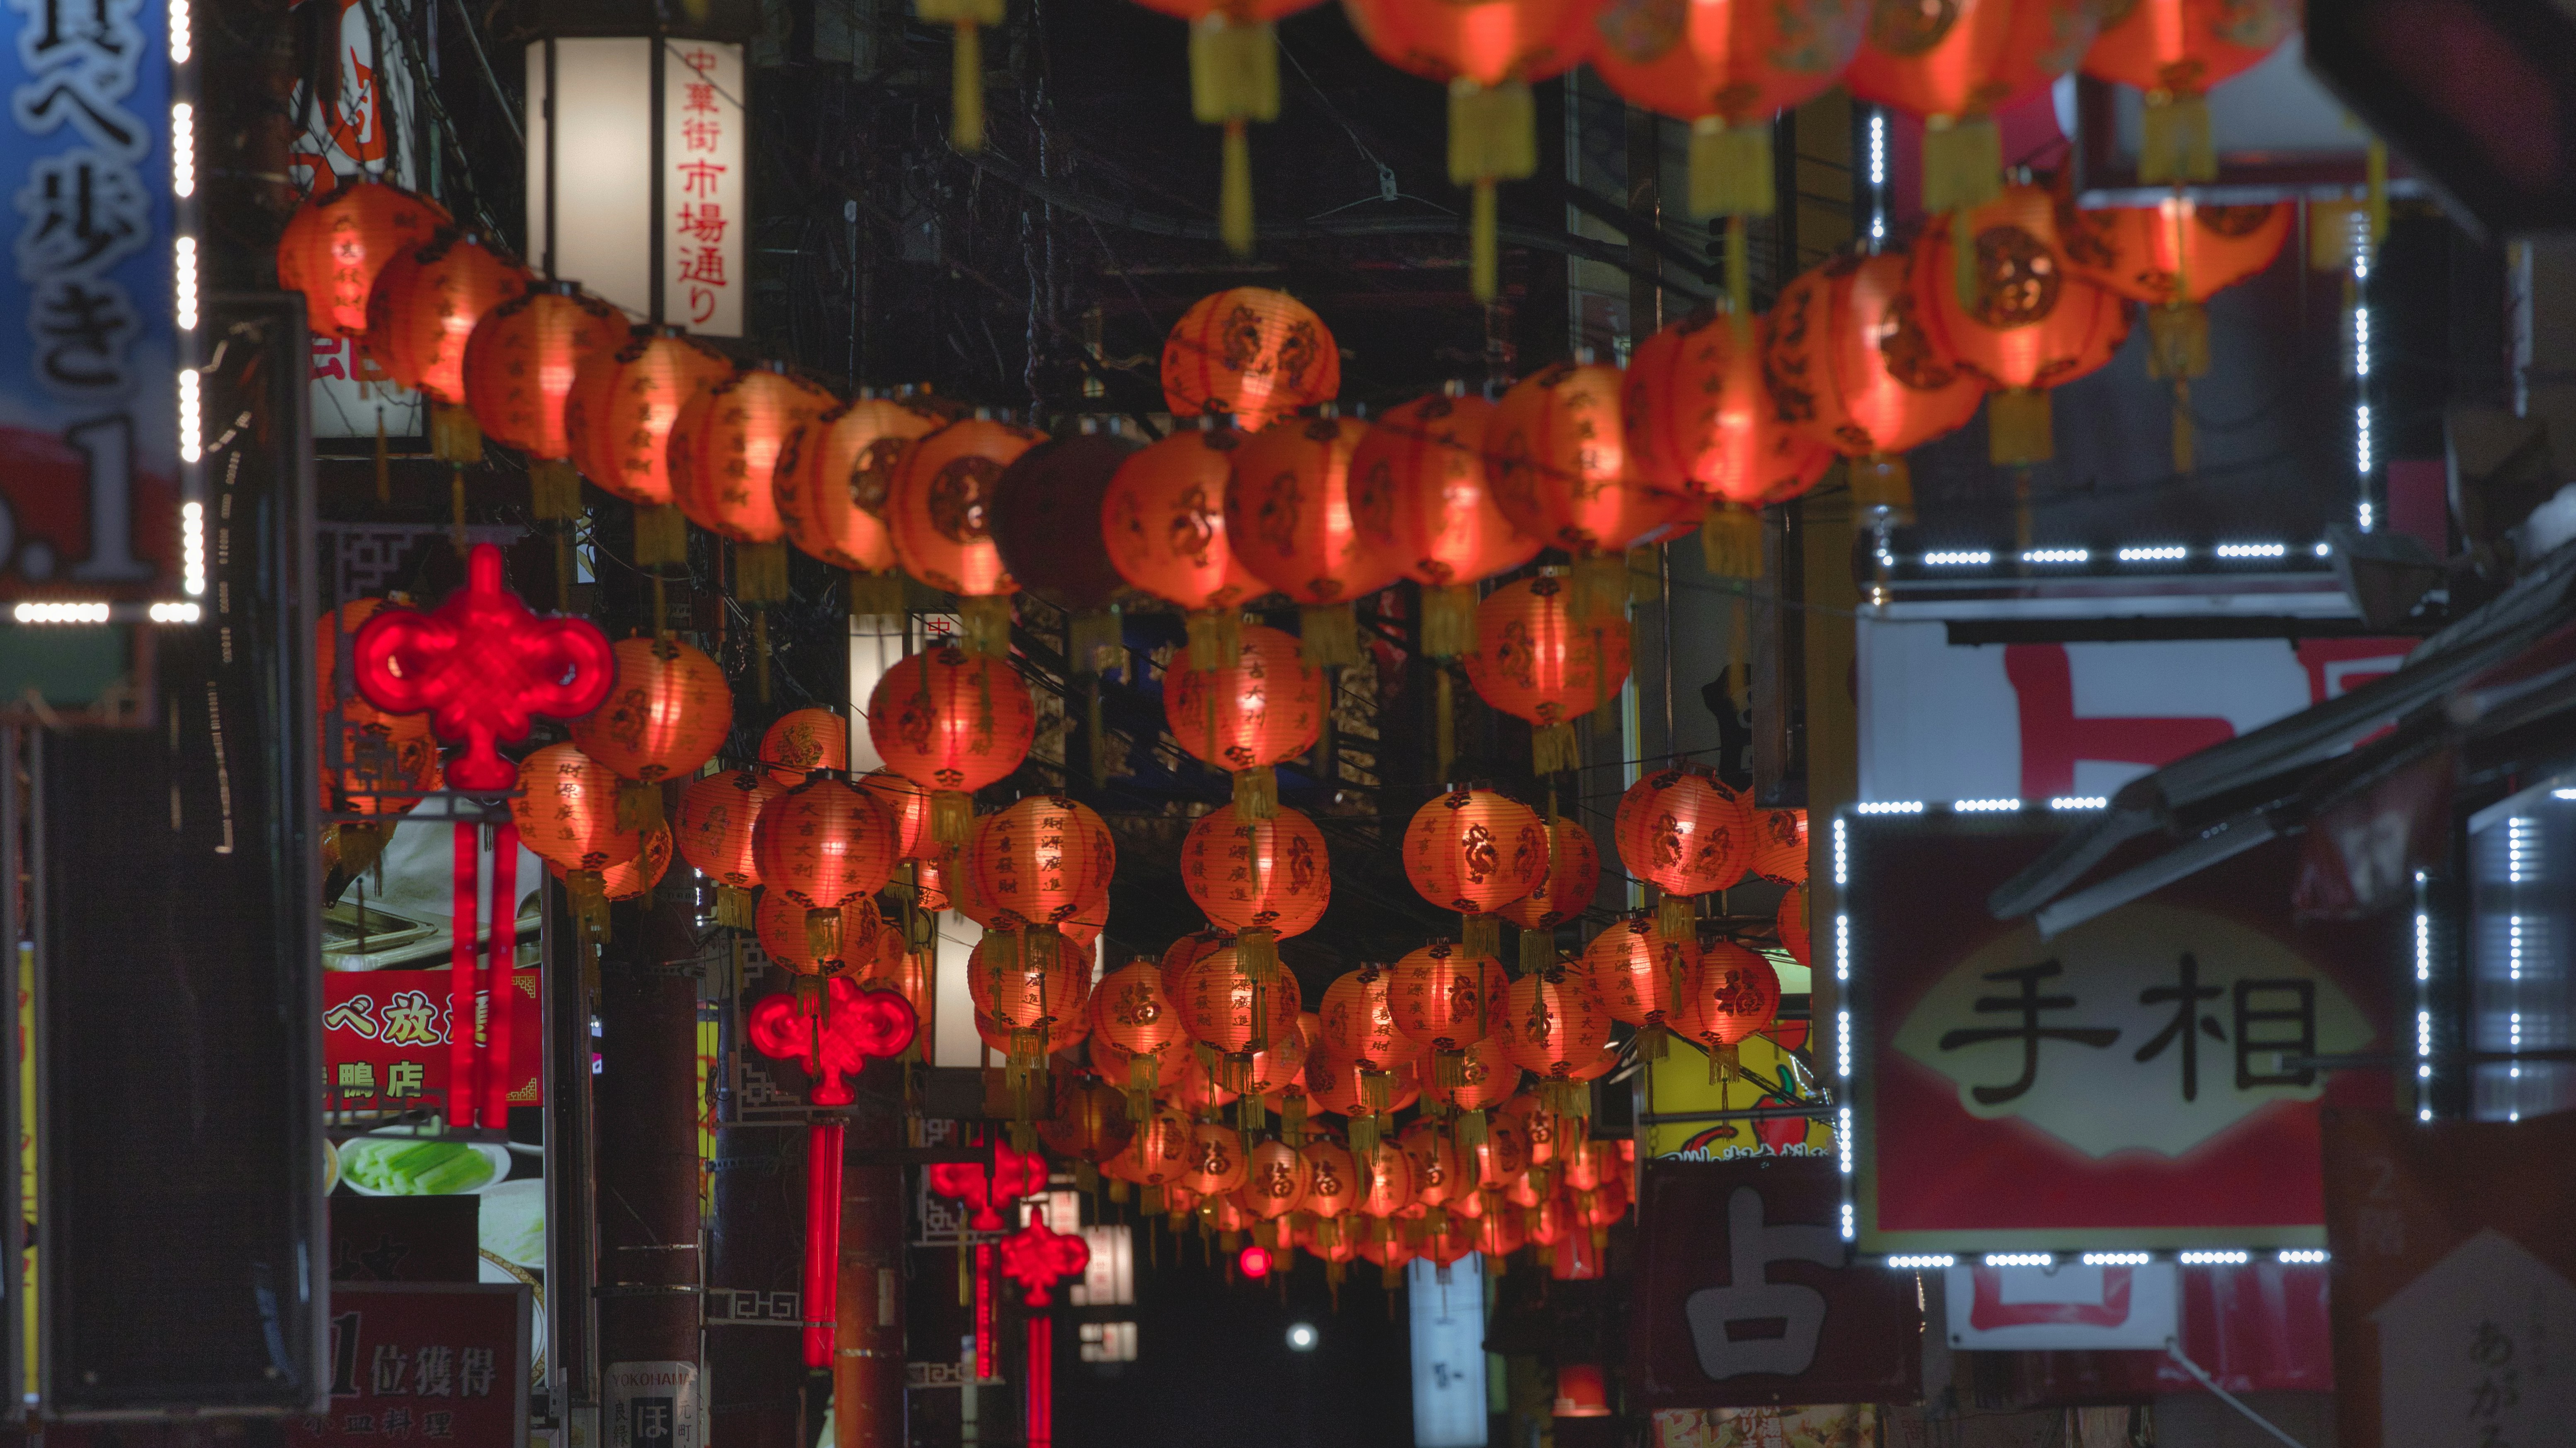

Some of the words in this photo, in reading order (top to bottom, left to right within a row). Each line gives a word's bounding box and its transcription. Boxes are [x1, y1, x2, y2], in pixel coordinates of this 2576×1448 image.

[677, 48, 728, 324] 中華街市場通り
[0, 410, 157, 580] .1
[791, 802, 819, 879] 大吉大利
[842, 807, 868, 885] 萬事如意
[995, 818, 1019, 894] 恭喜發財
[1041, 816, 1067, 891] 財源廣進
[1191, 822, 1213, 898] 恭喜發財
[1414, 817, 1441, 893] 萬事如意
[1194, 963, 1214, 1027] 恭喜發財
[1230, 964, 1252, 1026] 源廣進
[1615, 942, 1641, 1005] 財源廣進
[1369, 990, 1393, 1052] 恭喜發財
[1938, 951, 2316, 1103] 手相
[322, 1059, 424, 1098] 鴨店
[1685, 1186, 1845, 1381] 占
[330, 1311, 496, 1398] 1位獲得
[613, 1373, 691, 1387] YOKOHAMA
[678, 1400, 692, 1448] 元町
